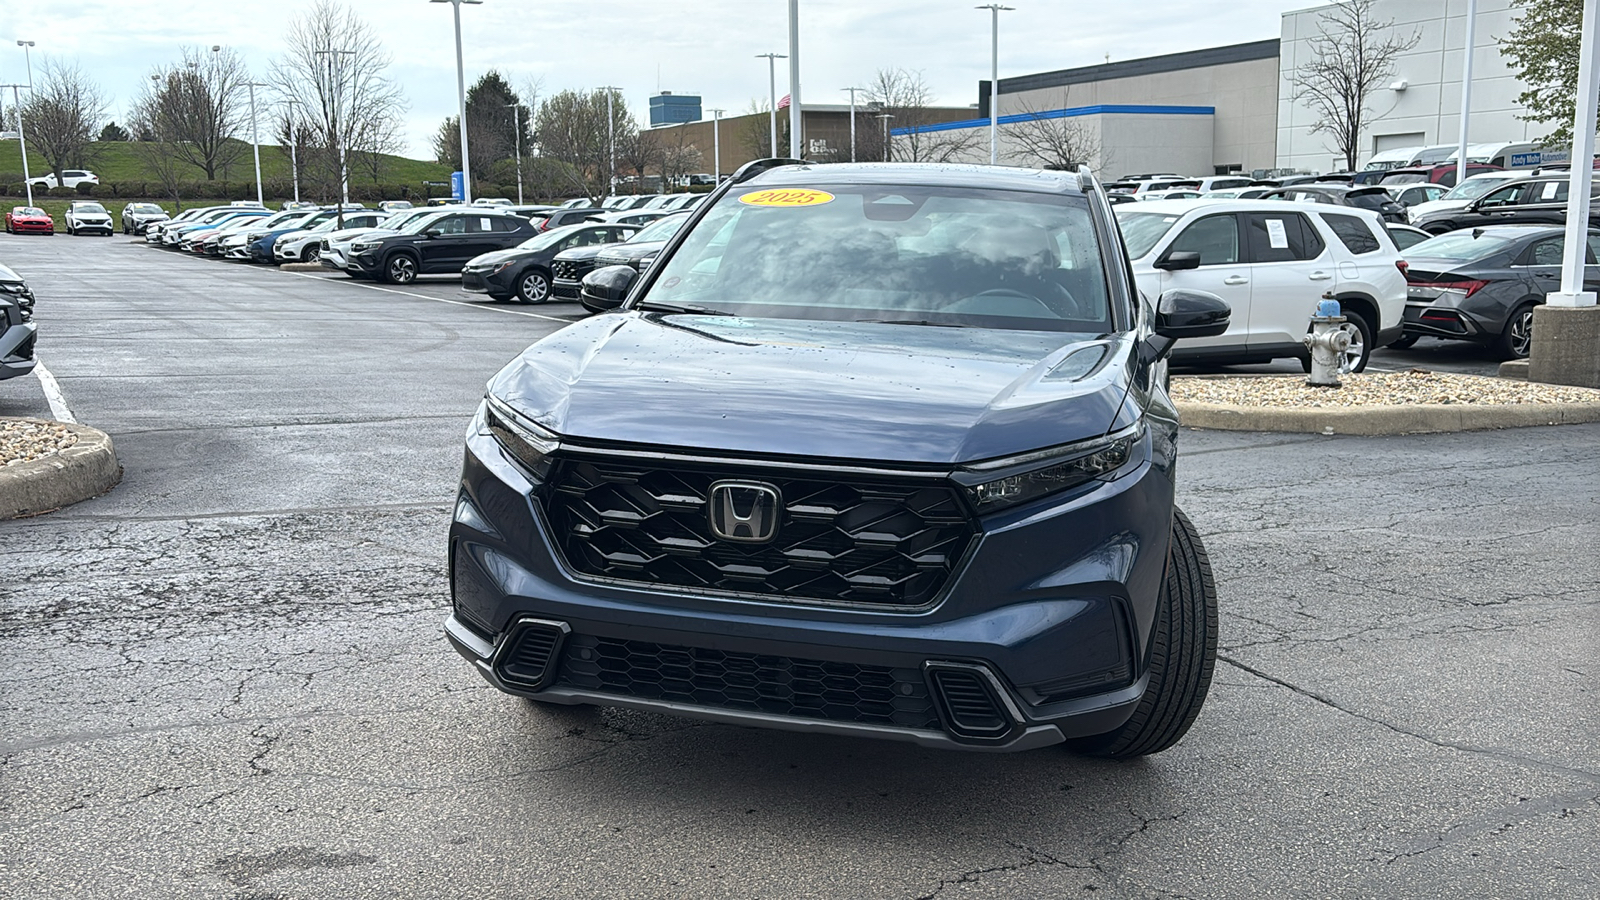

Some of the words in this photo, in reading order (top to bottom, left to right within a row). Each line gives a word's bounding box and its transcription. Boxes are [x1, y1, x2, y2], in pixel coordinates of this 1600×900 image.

[1512, 156, 1526, 165] Andy
[1526, 154, 1540, 164] Mohr
[1541, 153, 1567, 162] Automotive
[751, 192, 822, 204] 2025
